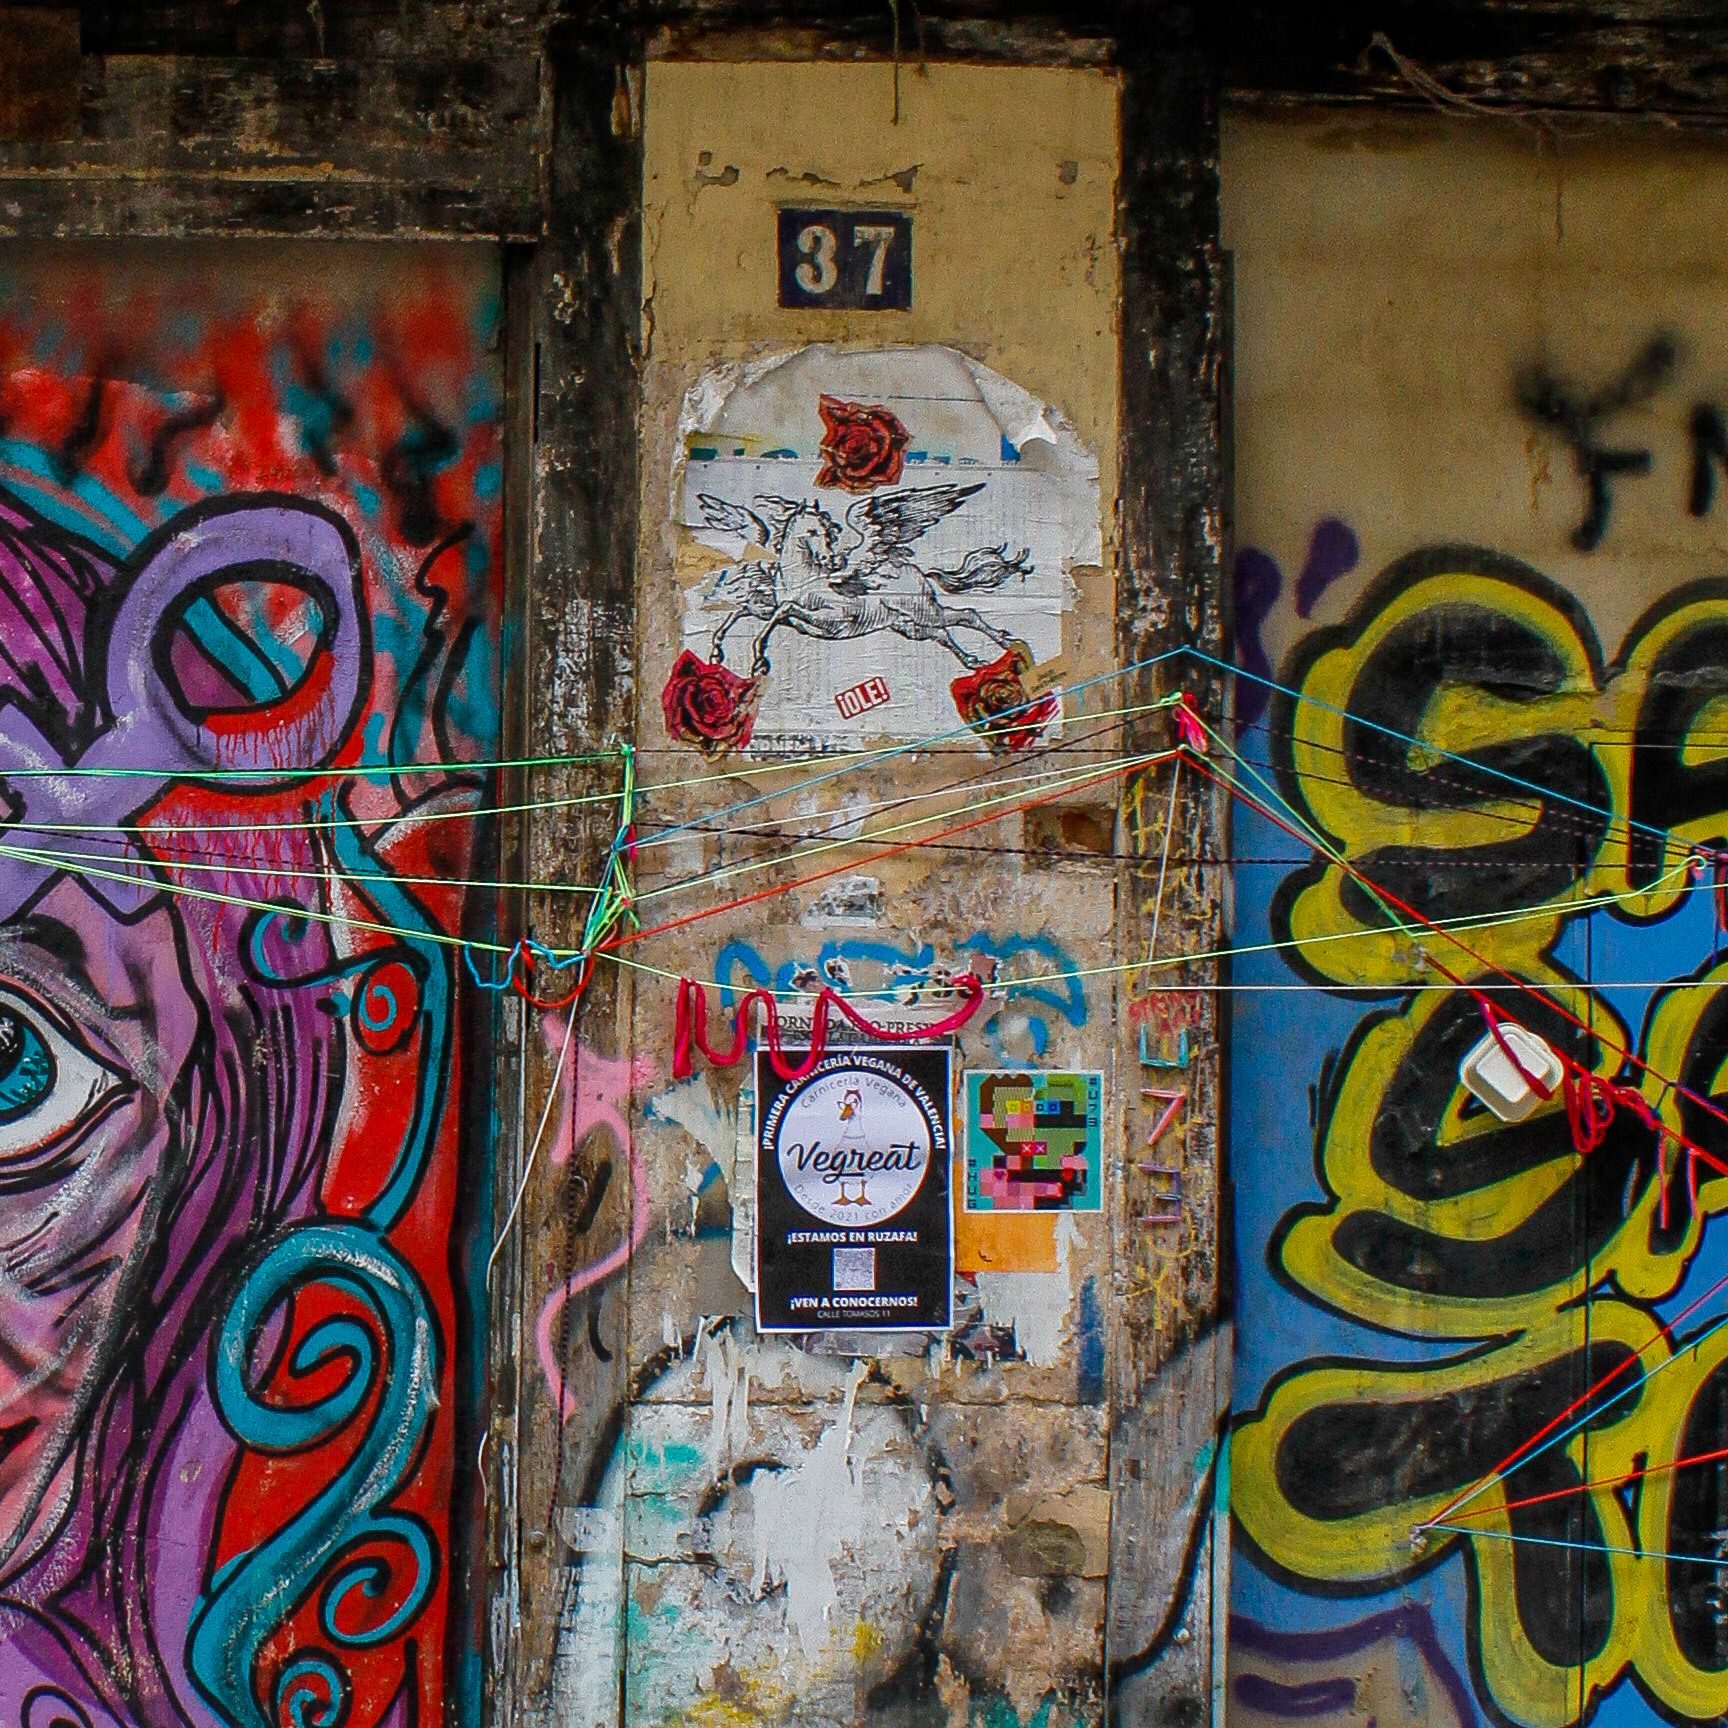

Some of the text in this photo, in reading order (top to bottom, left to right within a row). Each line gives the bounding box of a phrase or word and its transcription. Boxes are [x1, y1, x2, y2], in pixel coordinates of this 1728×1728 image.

[794, 225, 897, 295] 37
[852, 1055, 903, 1080] VEGANA
[901, 1073, 919, 1090] DE
[785, 1140, 922, 1184] Vegreat
[849, 1231, 866, 1243] EN
[867, 1231, 918, 1243] RUZAFA!
[820, 1297, 830, 1308] A
[831, 1297, 918, 1308] CONOCERNOS!
